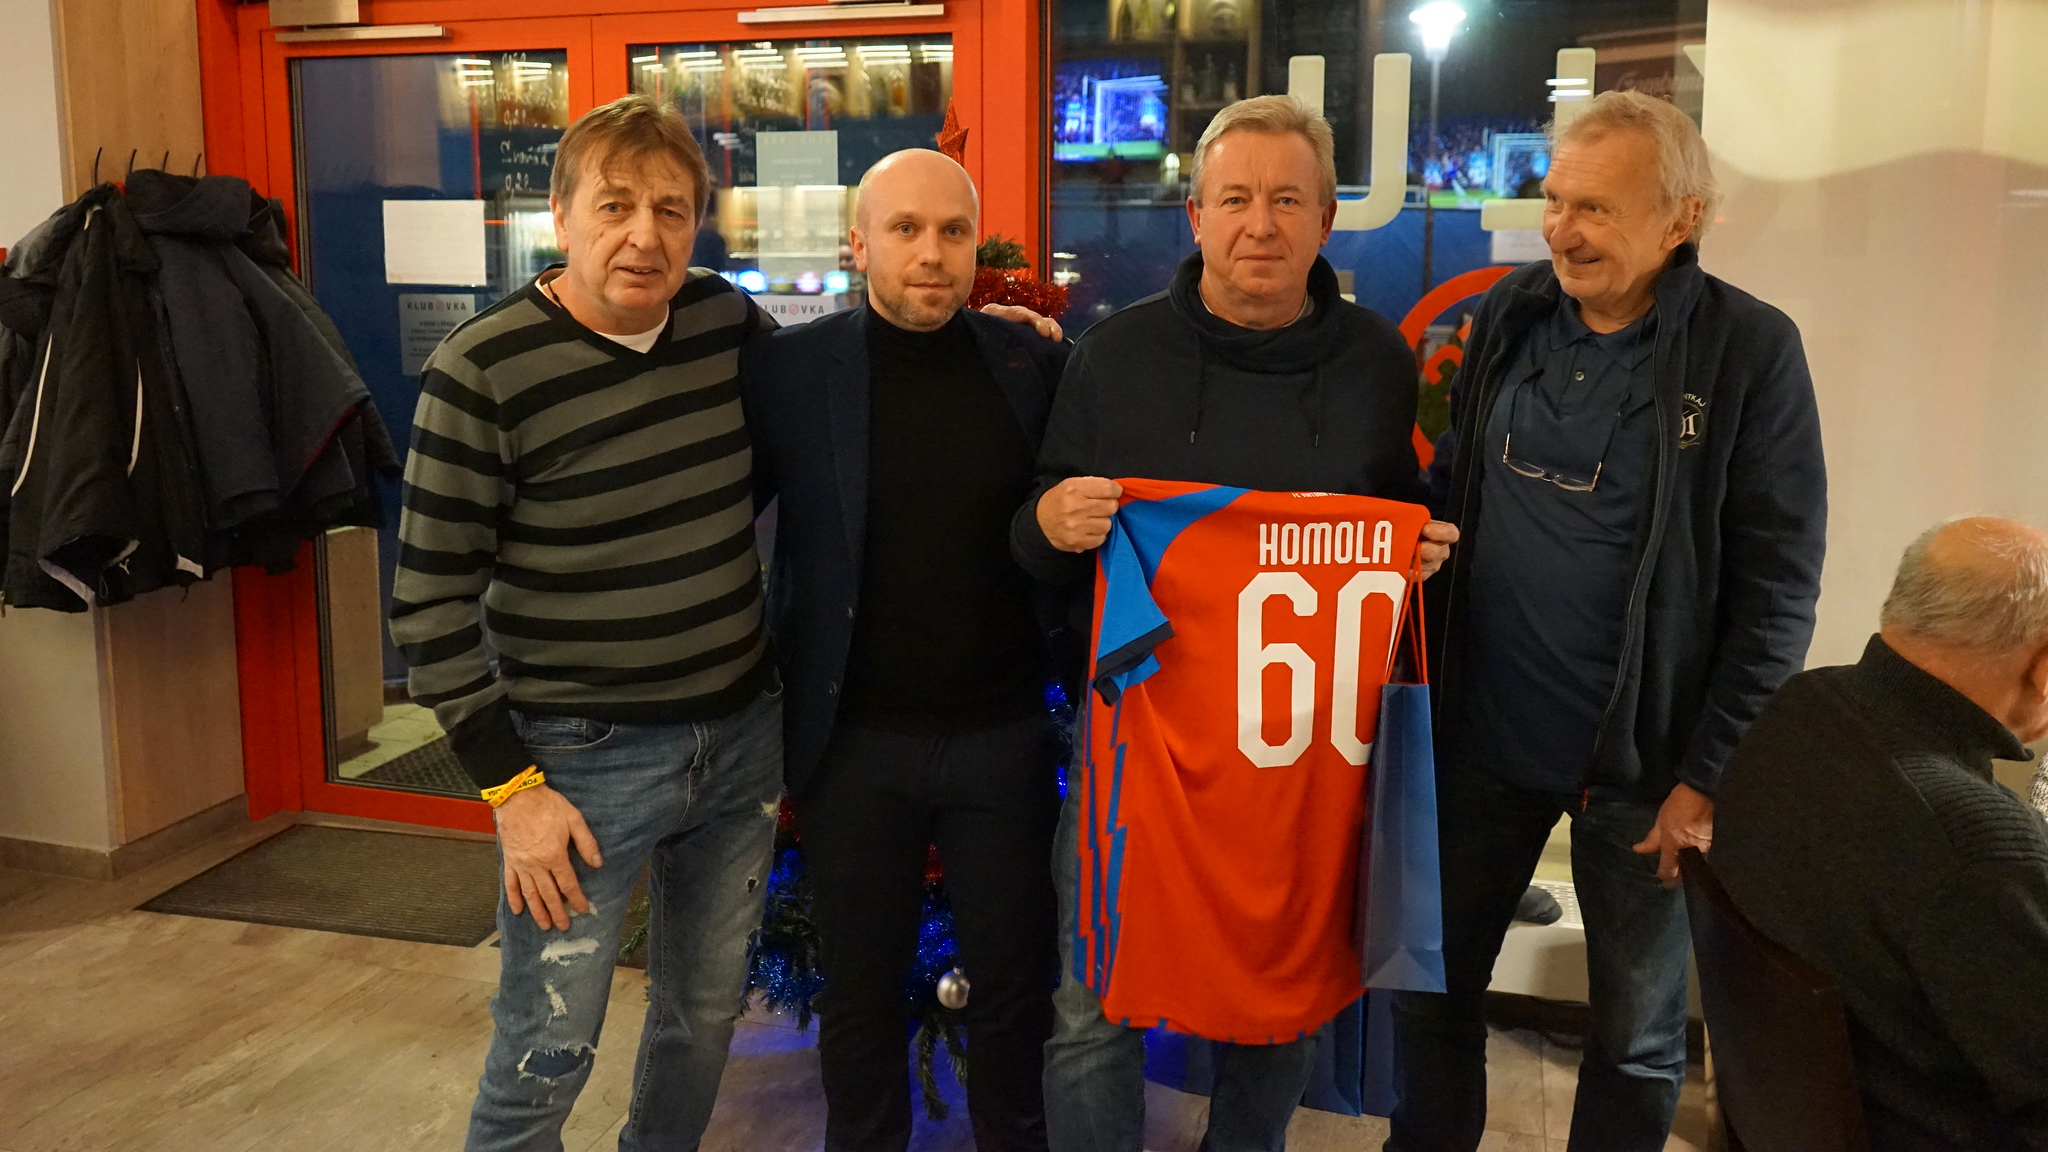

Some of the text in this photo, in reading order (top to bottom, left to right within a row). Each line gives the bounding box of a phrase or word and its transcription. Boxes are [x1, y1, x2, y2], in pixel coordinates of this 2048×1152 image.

[764, 303, 824, 315] UBOVKA
[1259, 520, 1393, 566] HOMOLA
[1237, 570, 1408, 769] 60
